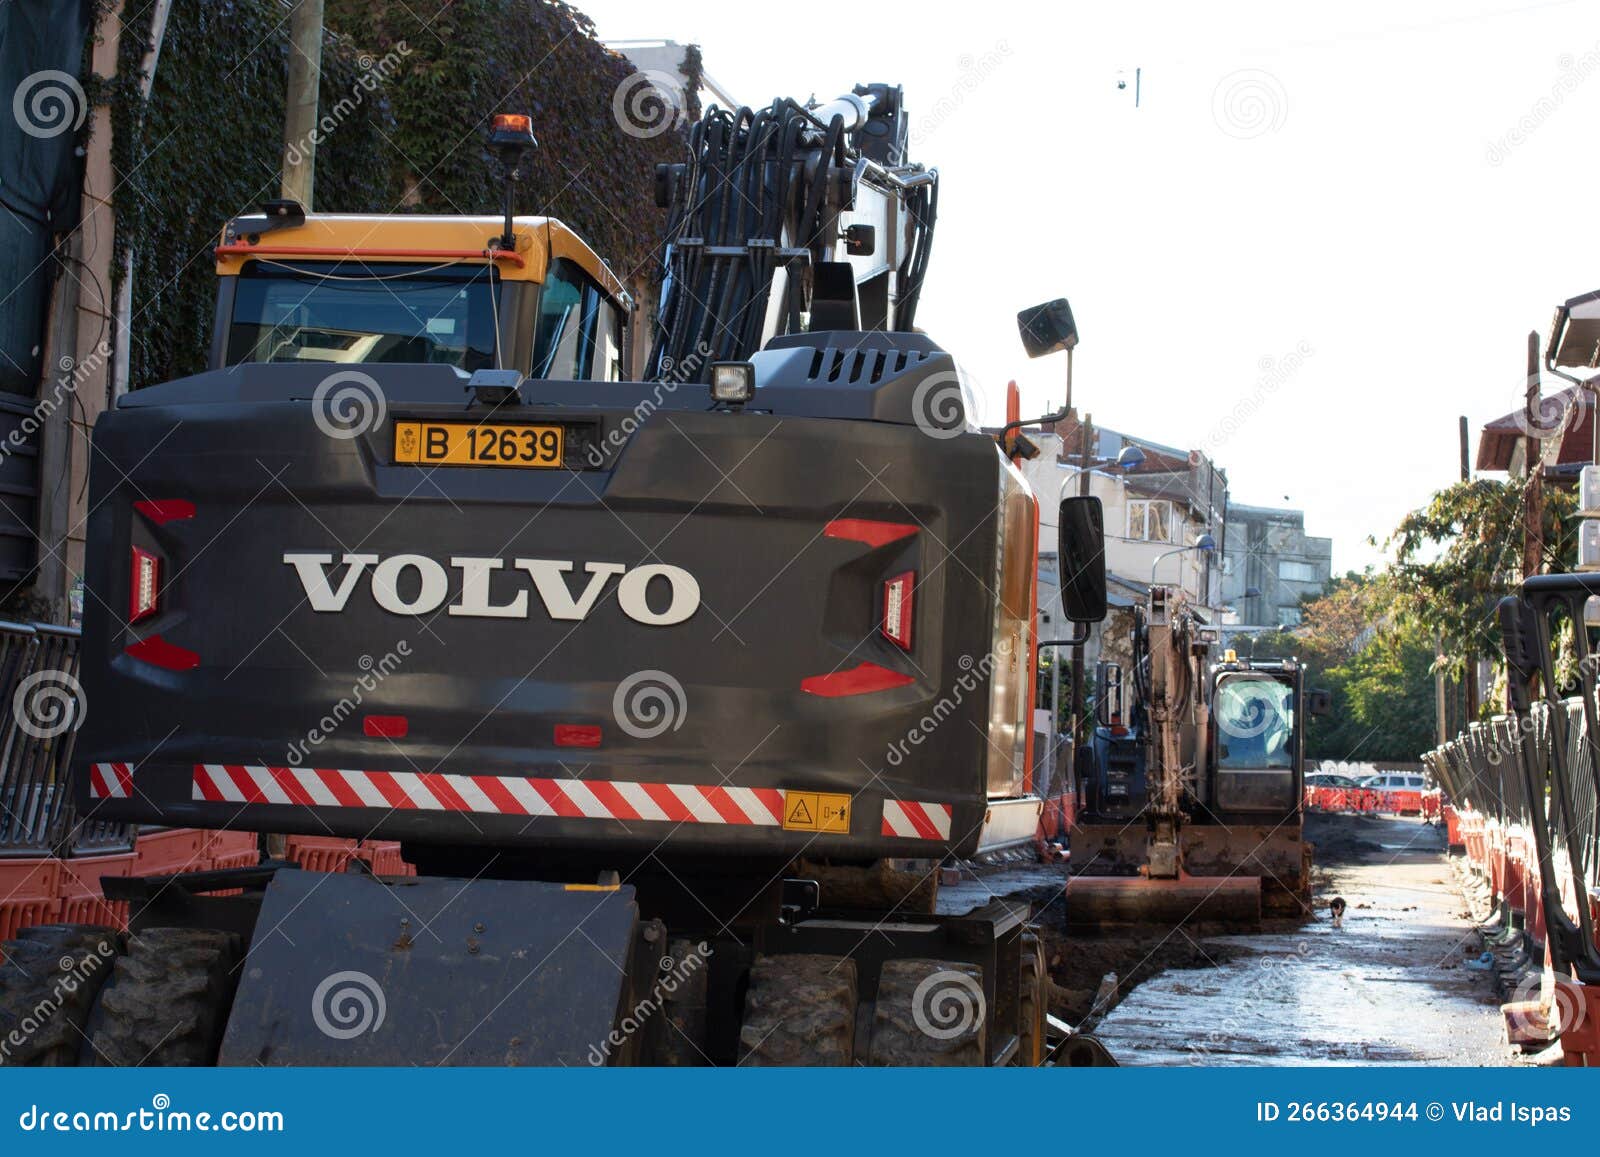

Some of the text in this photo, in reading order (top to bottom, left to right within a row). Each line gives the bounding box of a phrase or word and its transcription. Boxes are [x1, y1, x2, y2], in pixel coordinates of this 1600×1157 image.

[426, 427, 558, 462] B 12639
[283, 553, 701, 625] VOLVO
